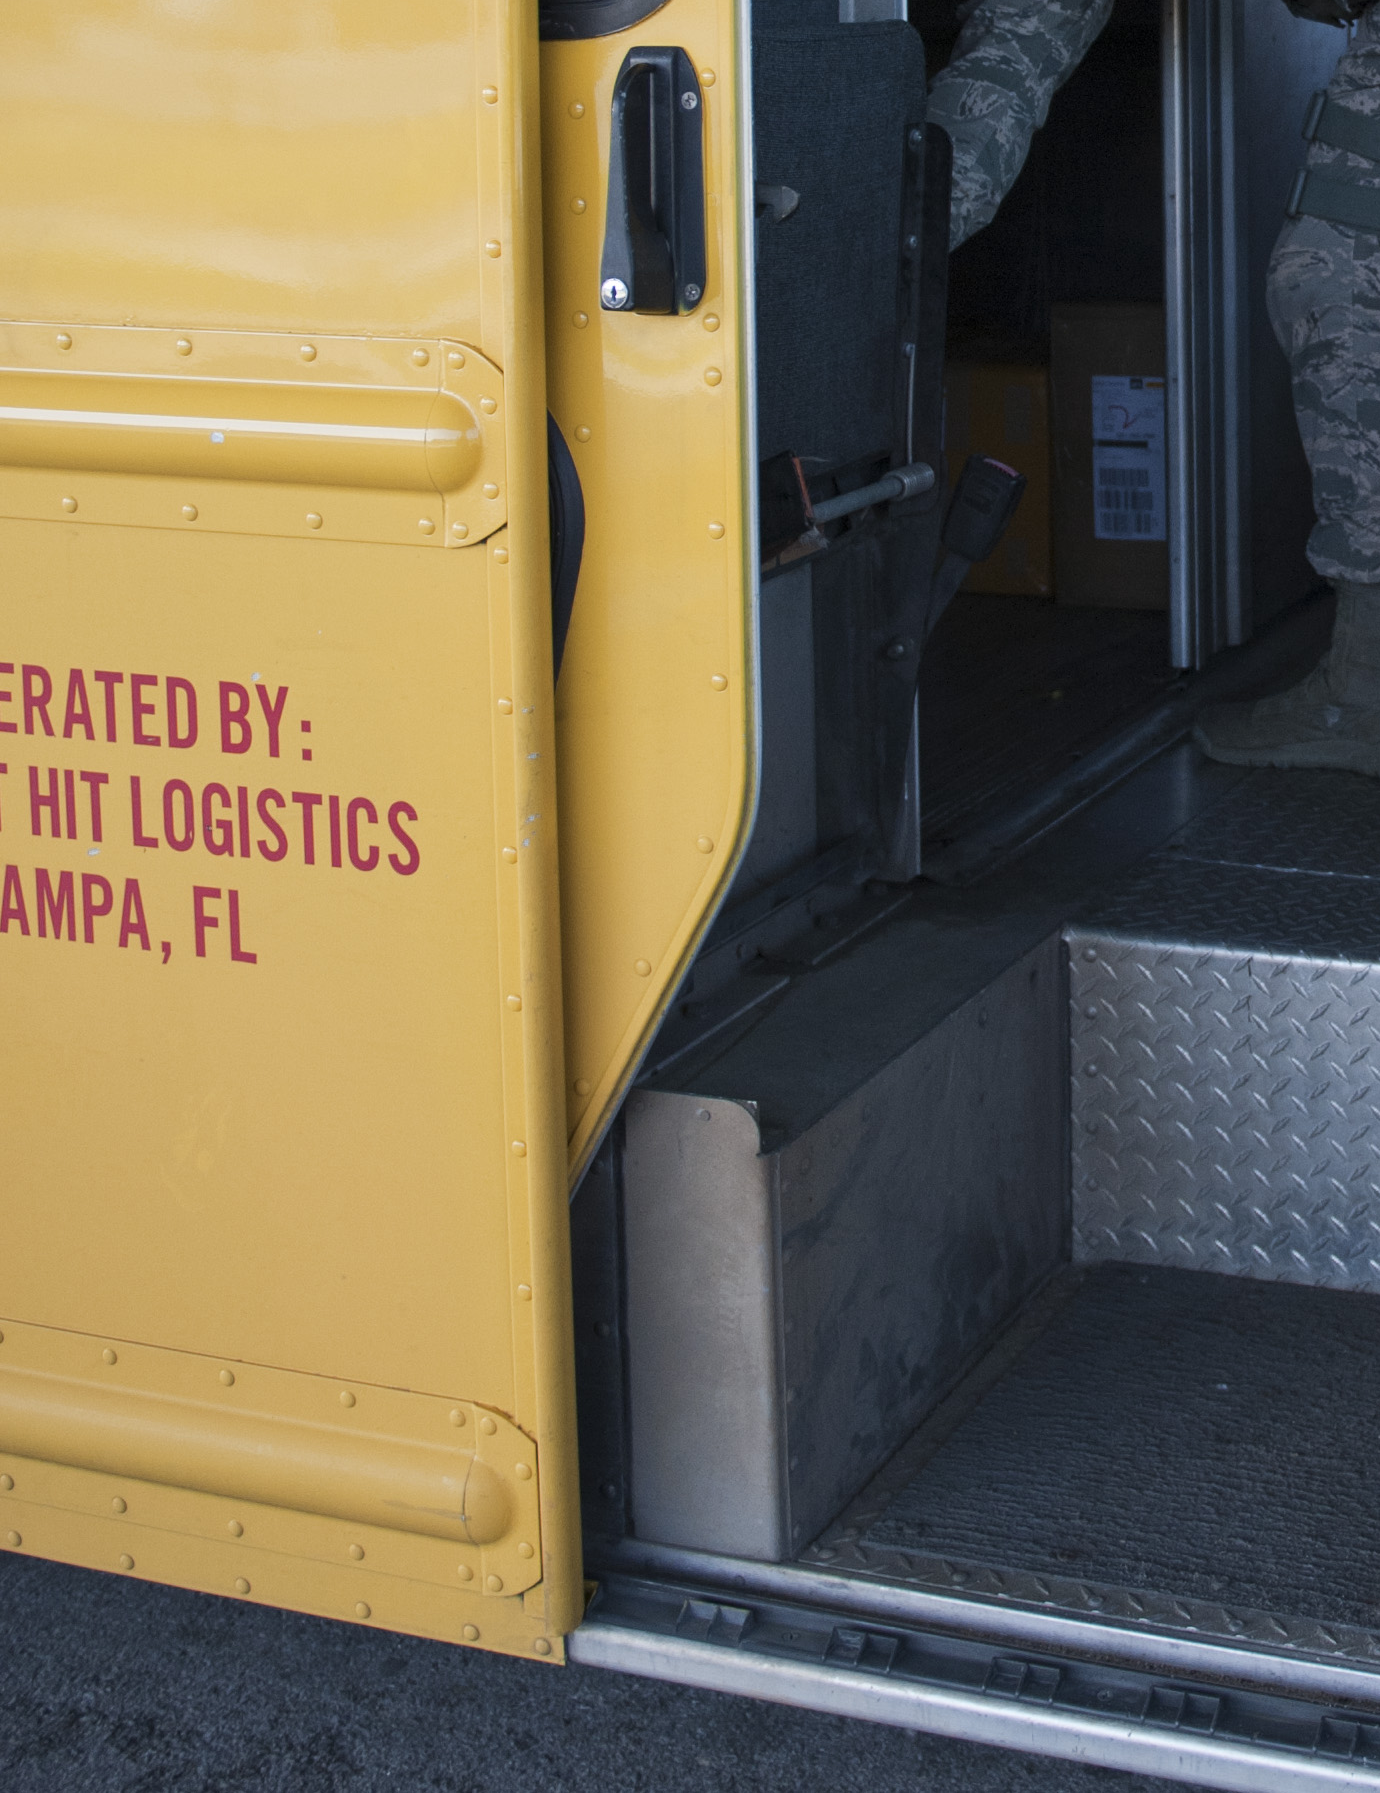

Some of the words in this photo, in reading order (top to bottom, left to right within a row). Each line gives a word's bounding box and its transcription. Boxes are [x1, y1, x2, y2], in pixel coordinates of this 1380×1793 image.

[218, 680, 313, 761] BY:
[28, 765, 109, 844] HIT
[130, 775, 420, 876] LOGISTICS
[0, 864, 172, 965] AMPA,
[192, 885, 258, 965] FL
